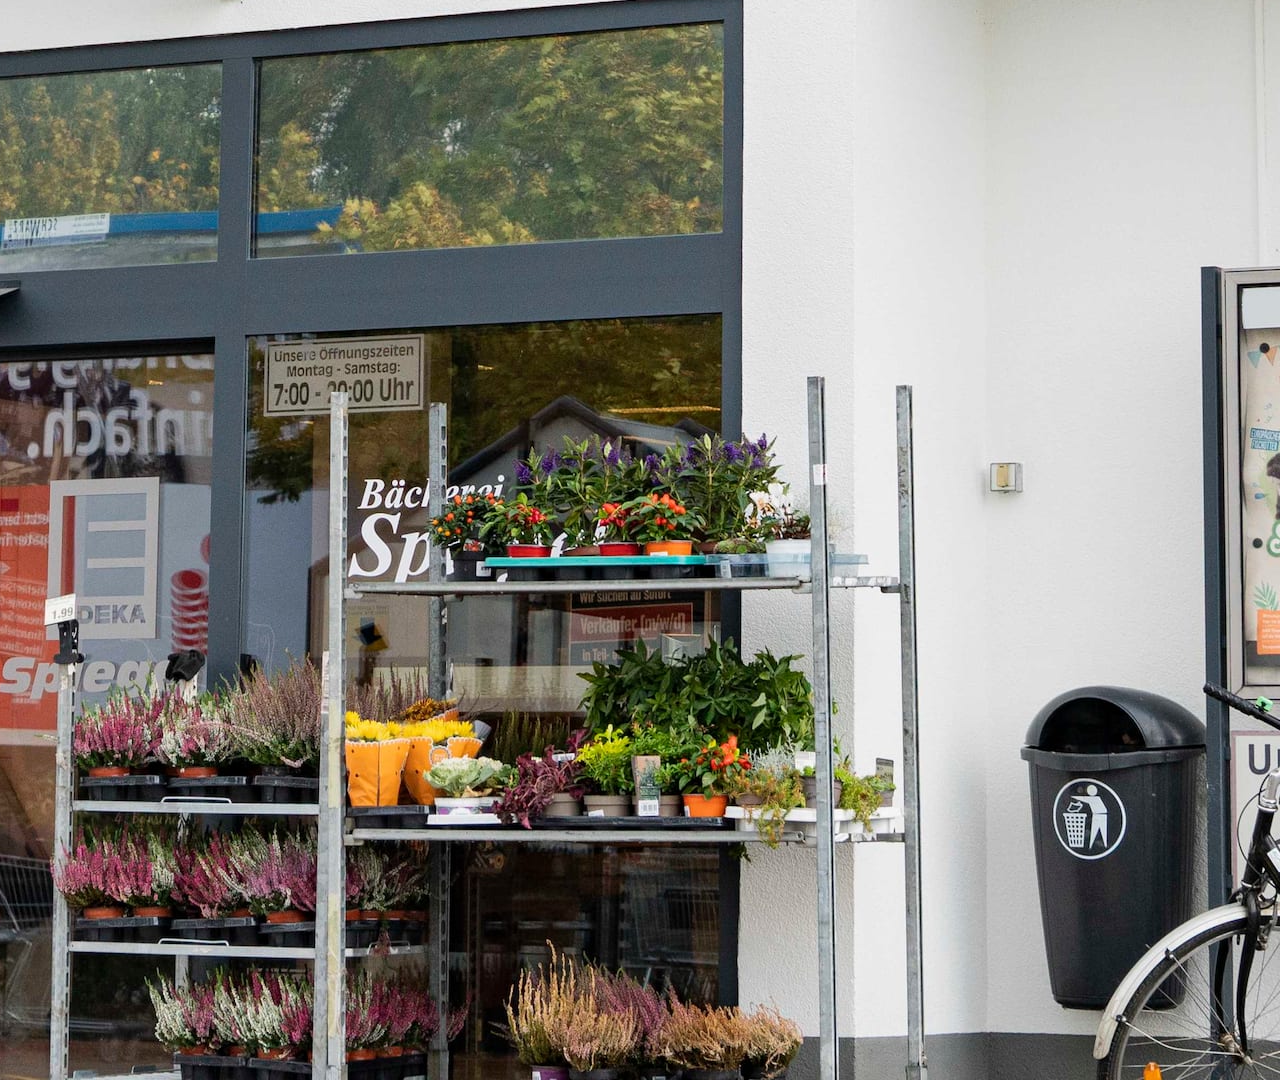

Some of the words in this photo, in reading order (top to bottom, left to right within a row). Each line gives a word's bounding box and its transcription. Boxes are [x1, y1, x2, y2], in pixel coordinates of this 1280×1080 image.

[274, 350, 316, 362] Unsere
[319, 345, 414, 361] Öffnungszeiten
[286, 365, 333, 378] Montag
[344, 362, 401, 375] Samstag:
[273, 382, 310, 407] 7:00
[379, 377, 415, 402] Uhr
[51, 606, 74, 620] 1.99
[78, 604, 146, 624] DEKA
[580, 614, 639, 635] Verkäufer
[640, 612, 686, 636] (m/w/d)
[582, 649, 591, 661] in
[592, 648, 610, 660] Teil-
